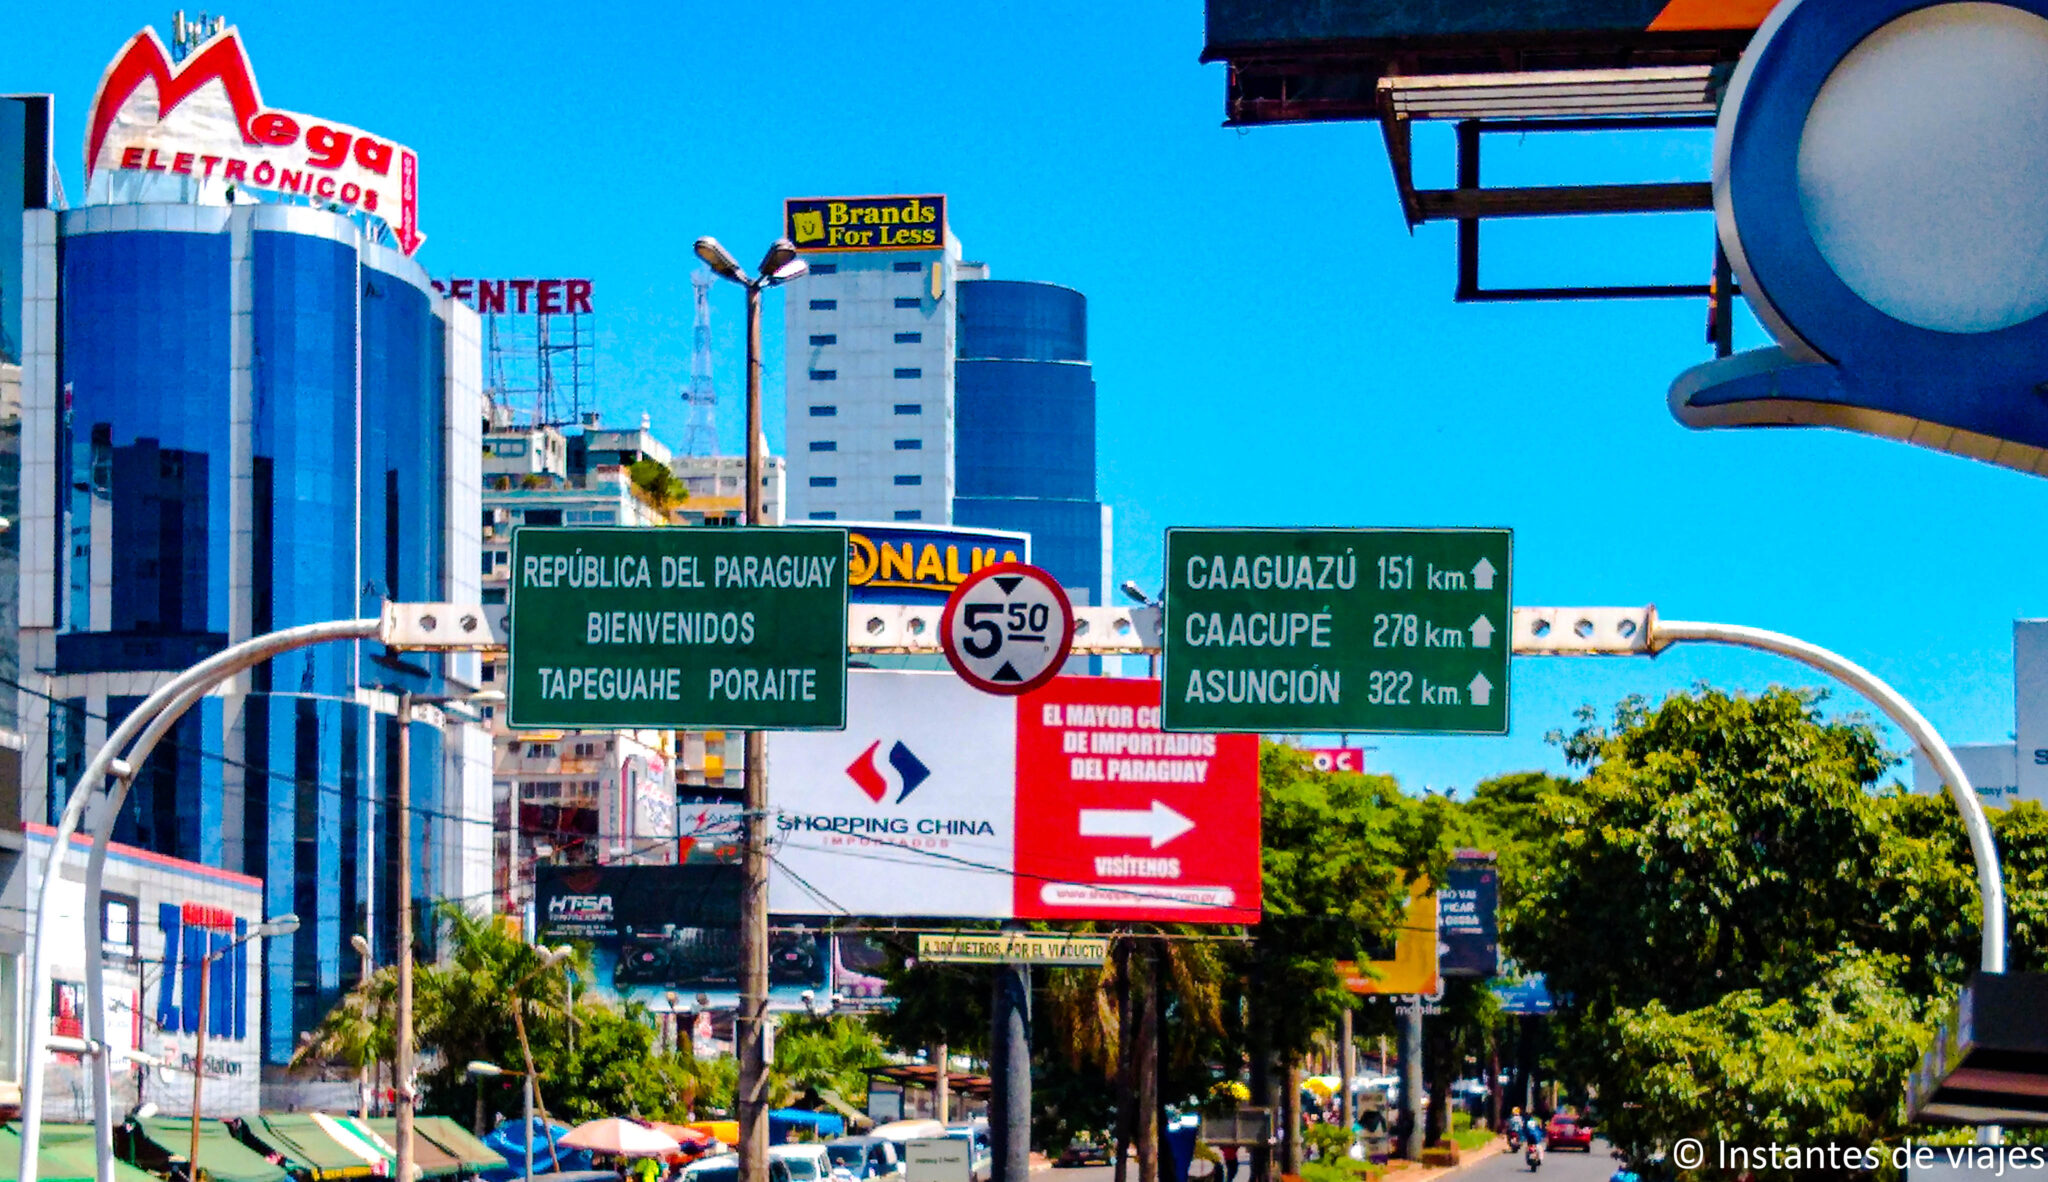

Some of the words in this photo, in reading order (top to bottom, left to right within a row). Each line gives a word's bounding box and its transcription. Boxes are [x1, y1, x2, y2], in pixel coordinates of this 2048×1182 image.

[86, 32, 393, 183] Mega
[120, 146, 378, 212] ELETRÔNICOS
[828, 200, 935, 226] Brands
[828, 227, 873, 246] For
[879, 226, 935, 245] Less
[523, 548, 651, 588] REPÚBLICA
[661, 556, 705, 588] DEL
[714, 555, 836, 588] PARAGUAY
[1187, 548, 1356, 590] CAAGUAZÚ
[1377, 556, 1413, 590] 151
[587, 612, 755, 644] BIENVENIDOS
[1185, 606, 1332, 647] CAACUPÉ
[1373, 614, 1418, 647] 278
[538, 668, 680, 700] TAPEGUAHE
[709, 668, 816, 700] PORAITE
[1185, 664, 1340, 704] ASUNCIÓN
[1368, 671, 1414, 705] 322
[1043, 703, 1063, 726] EL
[1066, 704, 1134, 728] MAYOR
[1063, 731, 1088, 753] DE
[1091, 732, 1216, 756] IMPORTADOS
[1071, 758, 1104, 780] DEL
[1107, 760, 1208, 783] PARAGUAY
[777, 816, 908, 834] SHOPPING
[917, 820, 995, 836] CHINA
[1094, 855, 1180, 878] VISÍTENOS
[1048, 943, 1104, 959] VIADUCTO
